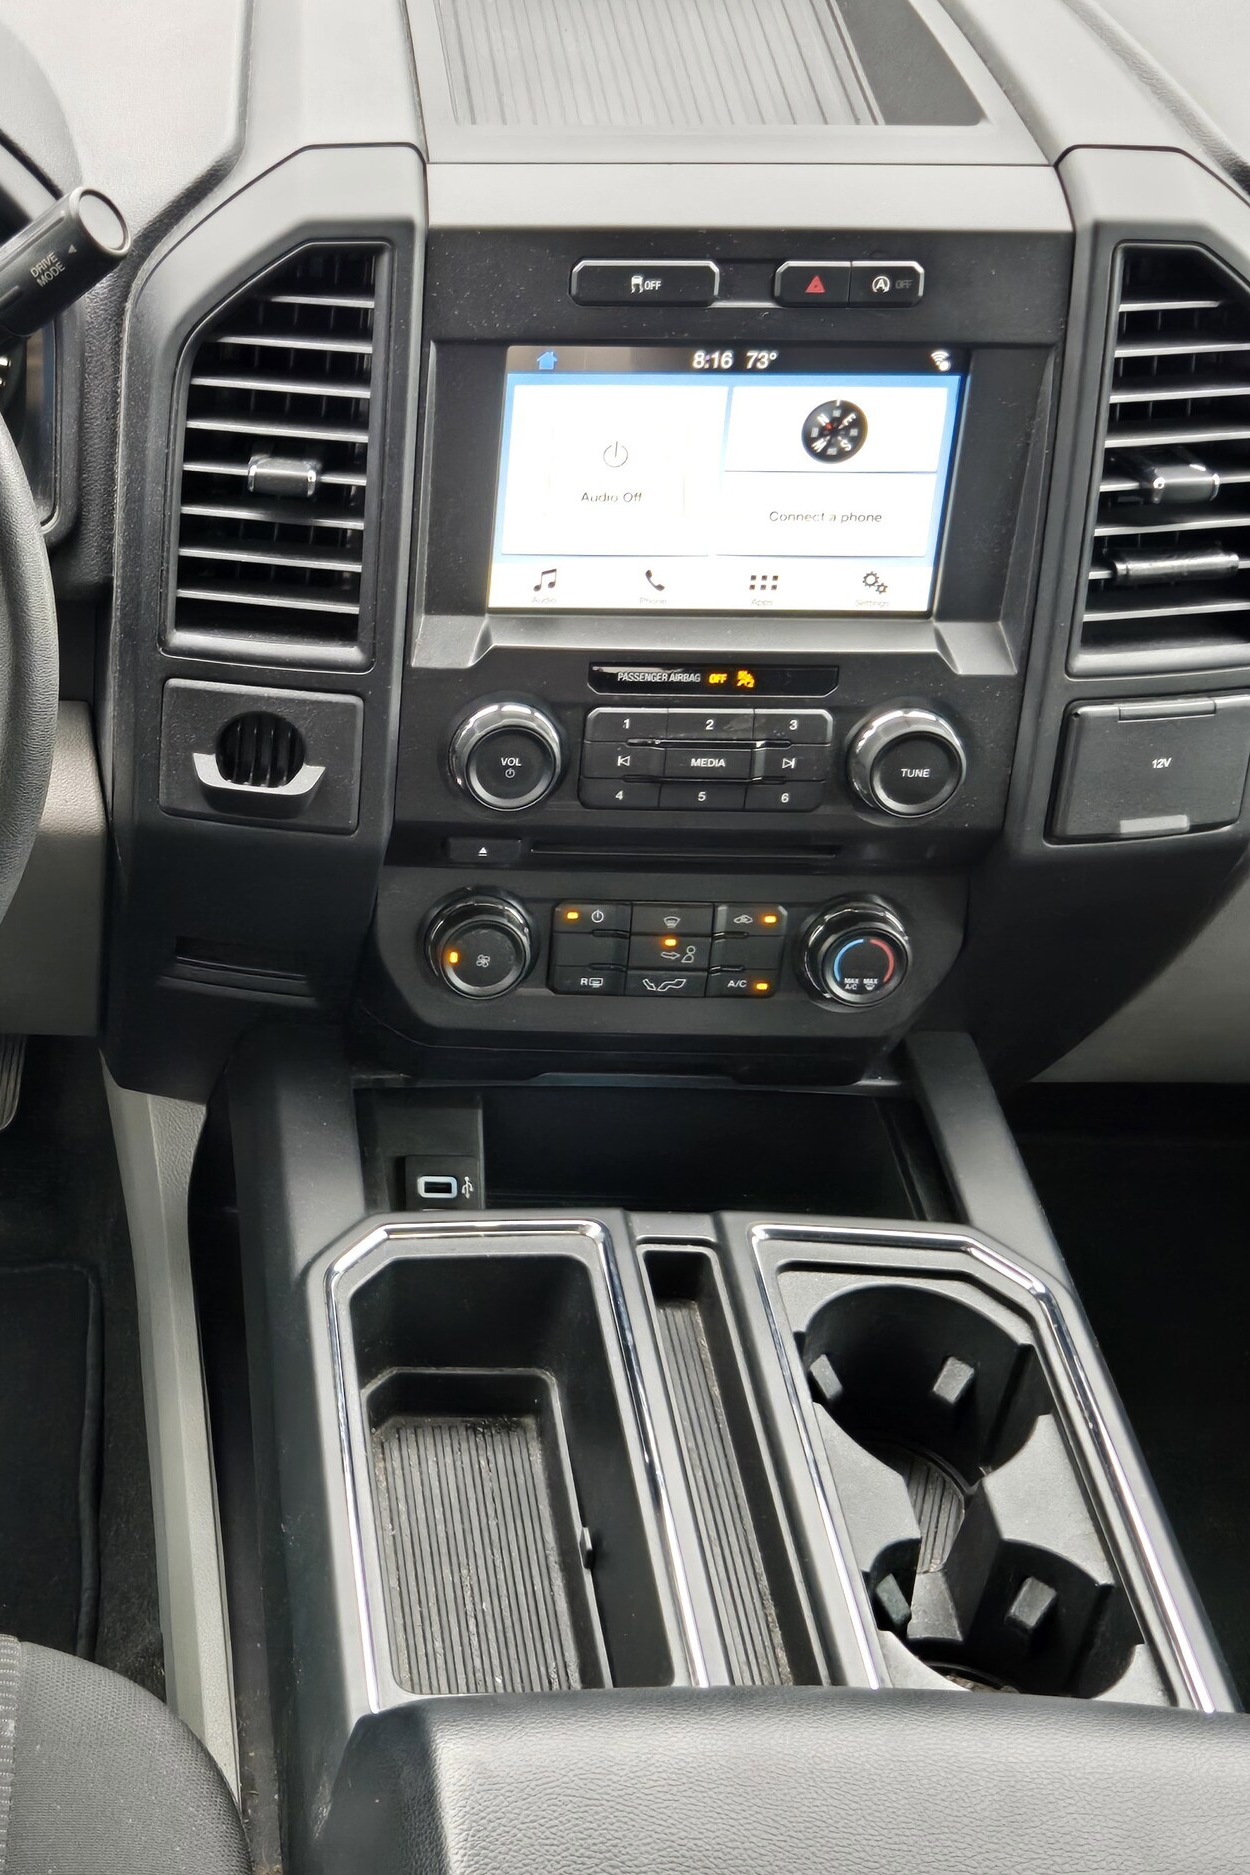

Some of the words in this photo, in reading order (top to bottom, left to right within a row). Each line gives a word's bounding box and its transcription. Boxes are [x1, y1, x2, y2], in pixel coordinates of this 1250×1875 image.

[30, 251, 59, 278] DRIVE
[36, 261, 66, 288] MODE
[644, 280, 662, 291] OFF
[692, 350, 734, 369] 8:16
[581, 491, 618, 503] Audio
[622, 491, 642, 503] Off
[769, 510, 825, 522] Connect
[840, 512, 882, 524] phone
[617, 672, 668, 683] PASSENGER
[669, 673, 701, 683] AIRBAG
[708, 673, 728, 684] OFF
[622, 718, 631, 730] 1
[704, 719, 716, 731] 2
[788, 719, 799, 731] 3
[500, 756, 523, 768] VOL
[690, 758, 727, 769] MEDIA
[1151, 757, 1173, 770] 12V
[901, 768, 930, 778] TUNE
[615, 790, 625, 802] 4
[697, 790, 708, 803] 5
[780, 792, 791, 805] 6
[580, 978, 589, 987] R
[726, 980, 748, 989] A/C
